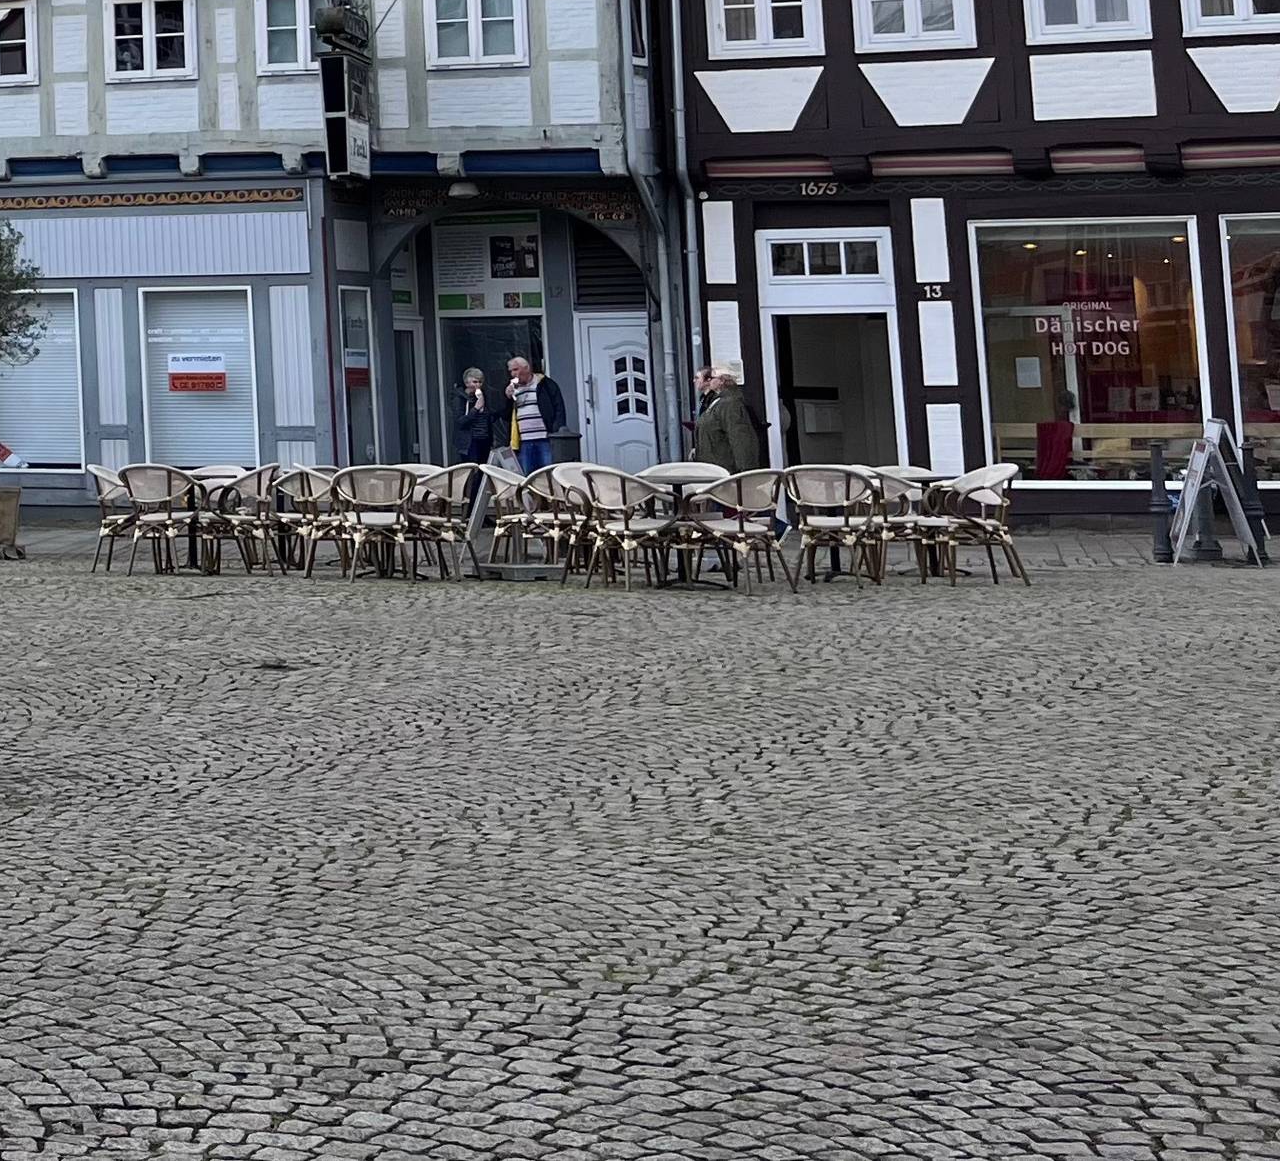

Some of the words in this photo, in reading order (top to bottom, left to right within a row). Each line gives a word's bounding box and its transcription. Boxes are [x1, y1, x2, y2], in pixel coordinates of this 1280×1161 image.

[800, 182, 839, 195] 1675
[924, 285, 942, 298] 13
[1062, 301, 1112, 310] ORIGINAL
[1035, 316, 1140, 333] Dänischer
[1051, 341, 1087, 356] HOT
[1092, 341, 1130, 356] DOG
